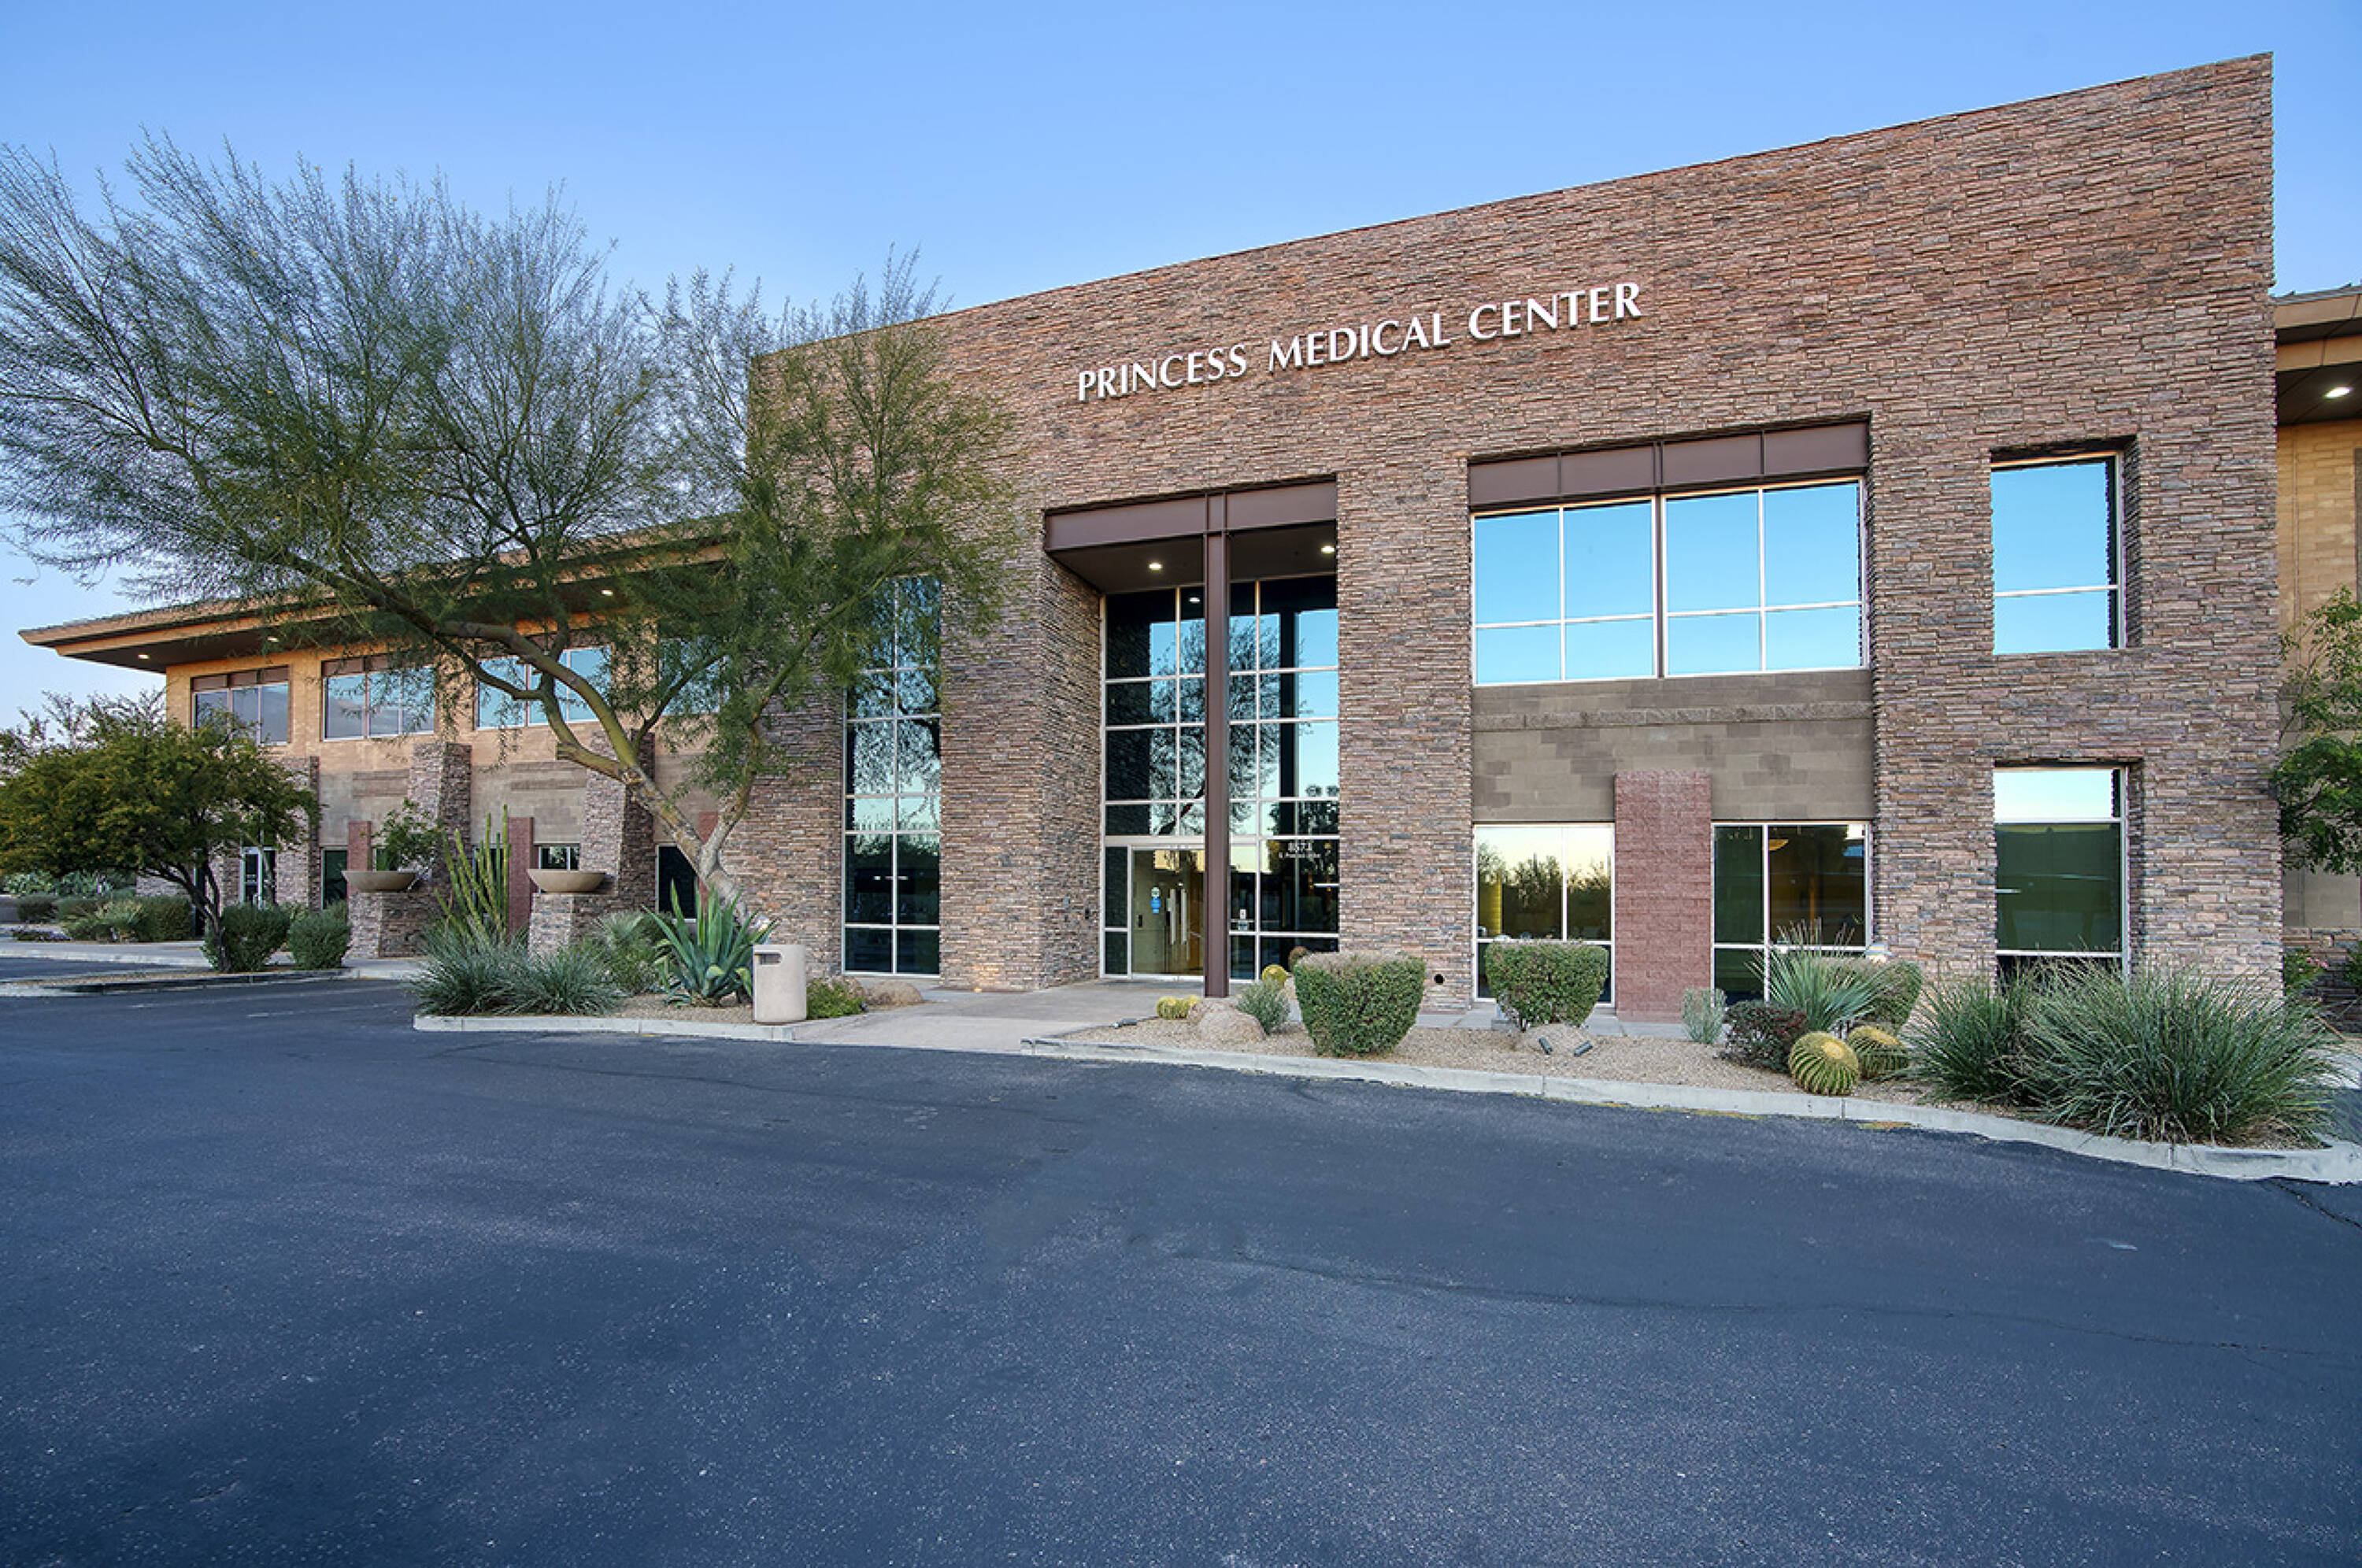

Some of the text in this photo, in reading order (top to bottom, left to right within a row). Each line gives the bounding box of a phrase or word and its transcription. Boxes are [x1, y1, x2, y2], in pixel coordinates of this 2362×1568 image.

[1077, 281, 1643, 402] PRINCESS MEDICAL CENTER
